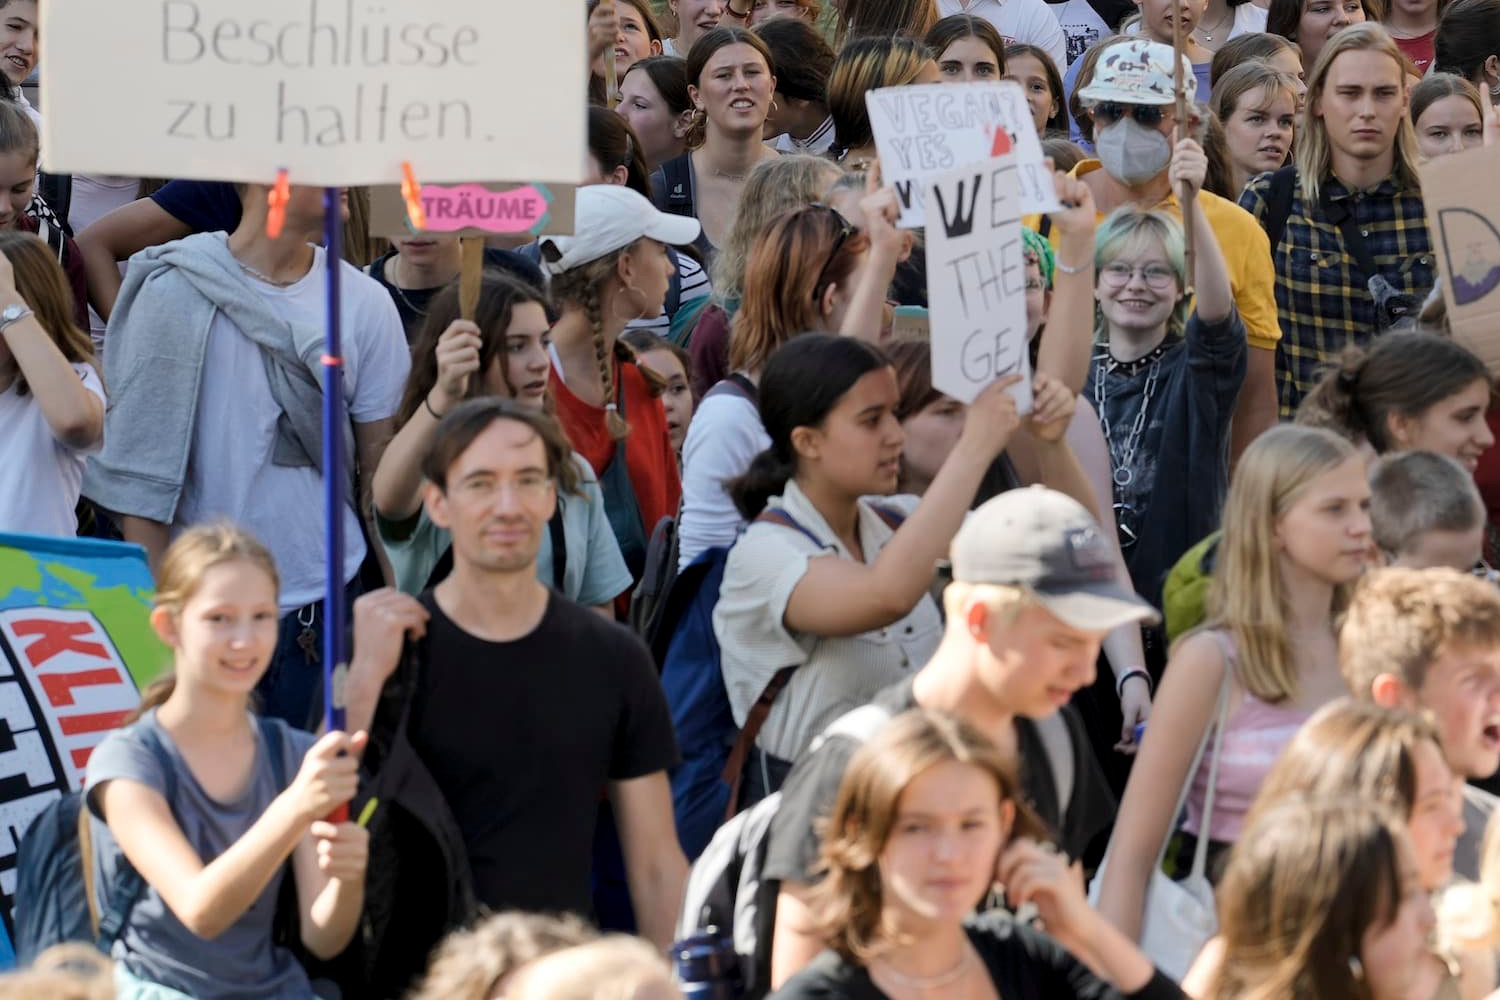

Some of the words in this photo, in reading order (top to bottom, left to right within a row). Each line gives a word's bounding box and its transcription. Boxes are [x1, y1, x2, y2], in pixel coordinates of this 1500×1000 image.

[165, 102, 236, 141] zu
[277, 80, 496, 148] halten.
[888, 135, 955, 171] YES
[424, 191, 537, 220] TRÄUME
[932, 164, 1021, 240] WE
[945, 237, 1027, 321] THE
